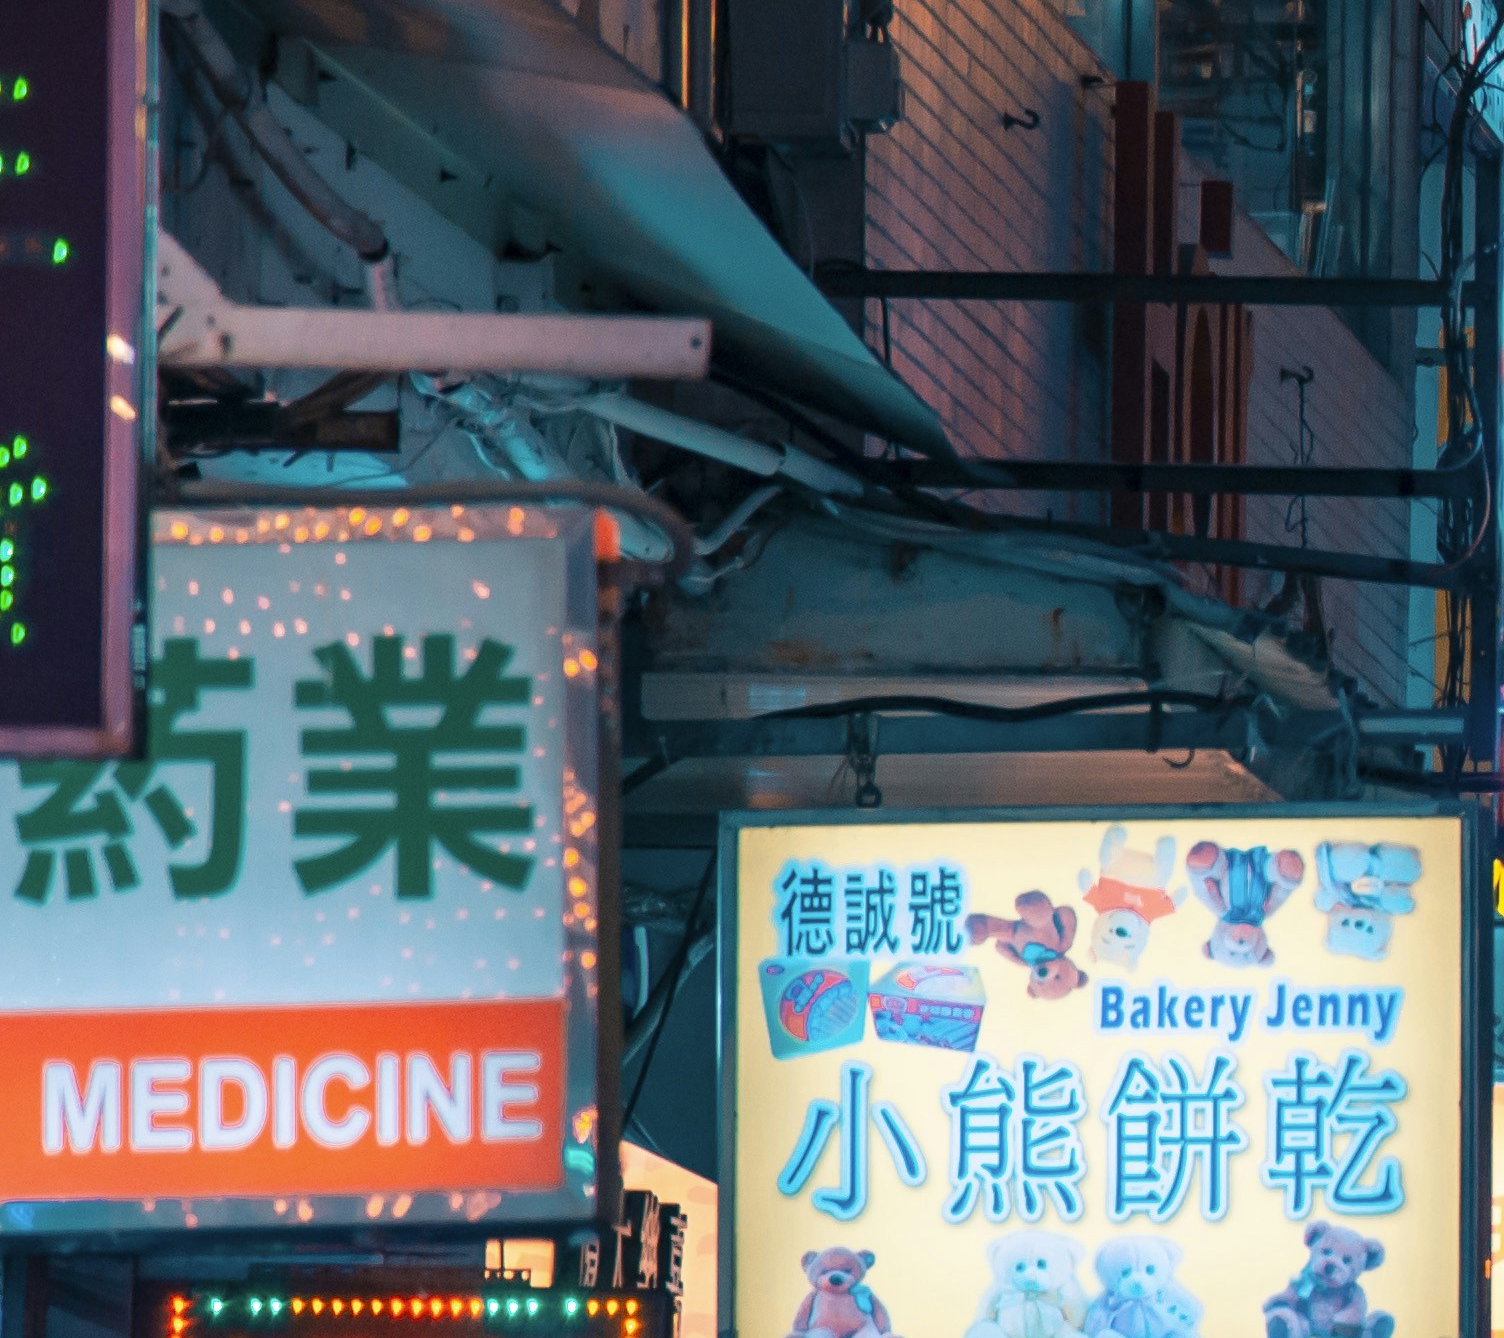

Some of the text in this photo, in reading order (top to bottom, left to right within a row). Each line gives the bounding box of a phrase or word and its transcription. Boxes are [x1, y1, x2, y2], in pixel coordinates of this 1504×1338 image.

[780, 864, 965, 959] 德誠號
[1098, 982, 1402, 1042] Bakery Jenny
[41, 1051, 543, 1156] MEDICINE
[778, 1051, 1409, 1223] 小熊餅乾
